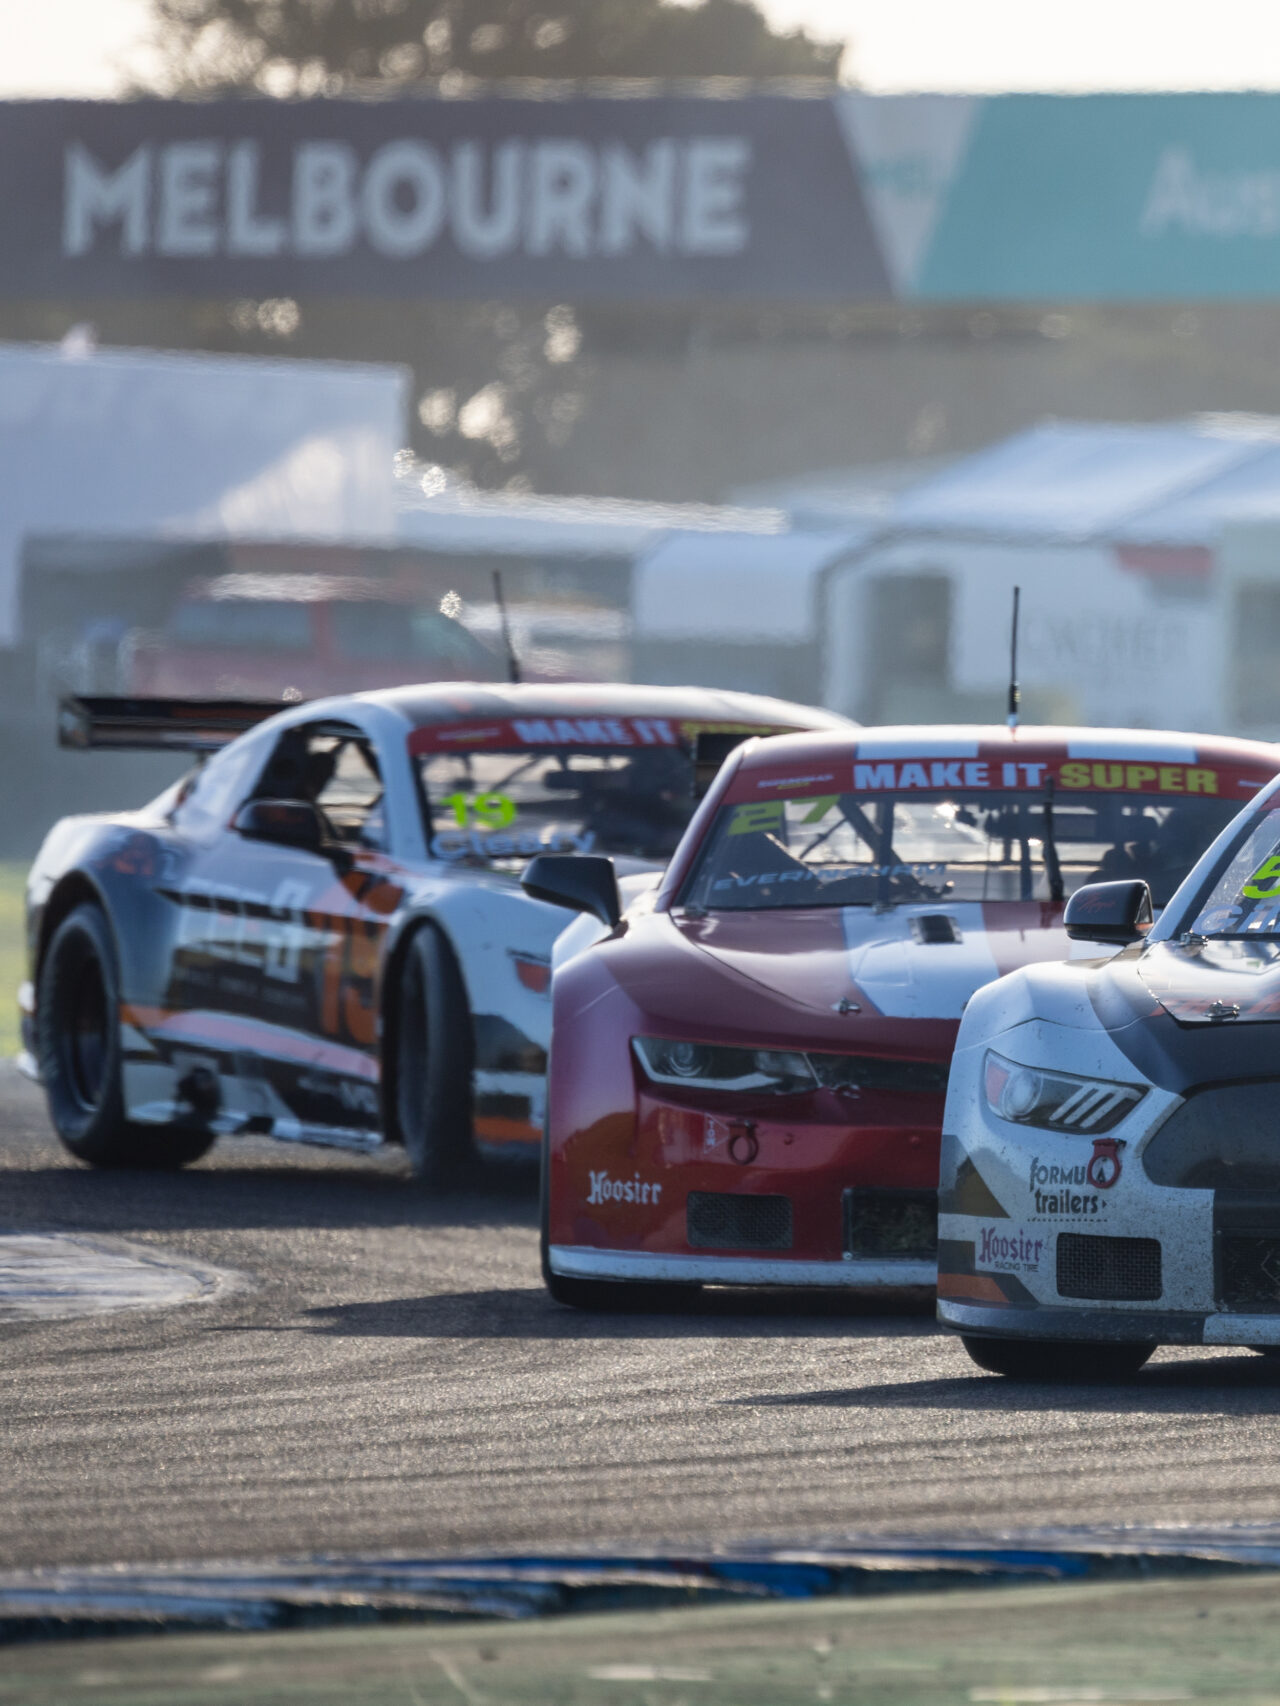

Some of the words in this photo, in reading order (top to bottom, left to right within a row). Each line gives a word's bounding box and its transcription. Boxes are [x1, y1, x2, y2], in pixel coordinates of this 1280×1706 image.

[62, 137, 752, 258] MELBOURNE
[853, 761, 991, 790] MAKE
[1001, 762, 1048, 788] IT
[1059, 763, 1219, 794] SUPER
[440, 791, 518, 829] 19
[727, 794, 841, 836] 27
[430, 829, 597, 859] Cleary
[585, 1169, 663, 1206] Hoosier
[1034, 1187, 1099, 1215] trailers
[978, 1226, 1044, 1264] Hoosier
